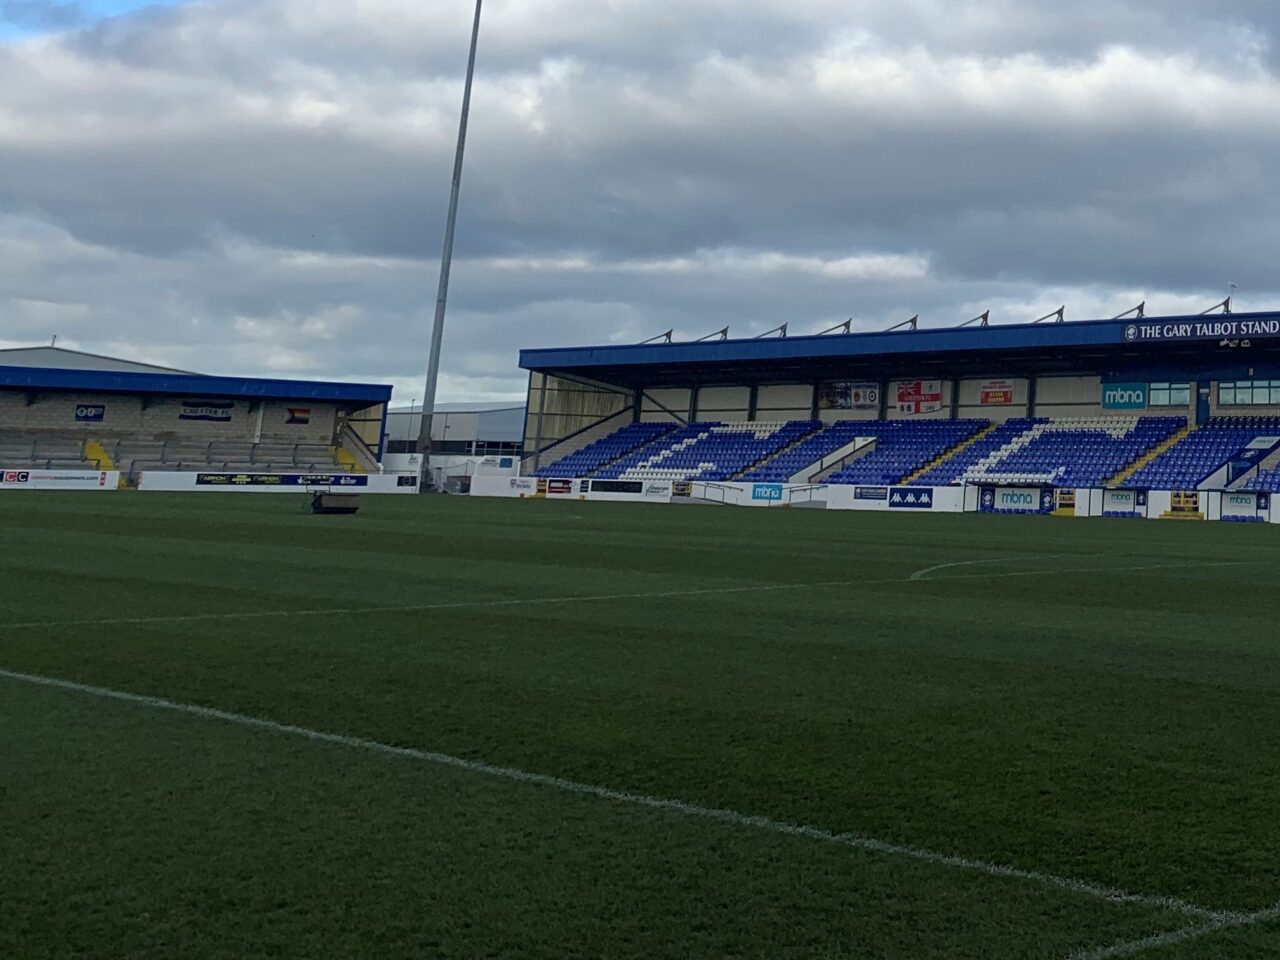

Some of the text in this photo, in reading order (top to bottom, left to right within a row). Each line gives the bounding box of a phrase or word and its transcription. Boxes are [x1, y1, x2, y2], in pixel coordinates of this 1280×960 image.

[1140, 320, 1280, 338] THE GARY TALBOT STAND
[1105, 387, 1143, 404] mbna
[755, 486, 780, 499] mbna
[1001, 490, 1033, 505] mbna
[1110, 492, 1131, 502] mbna
[1229, 494, 1252, 505] mbna
